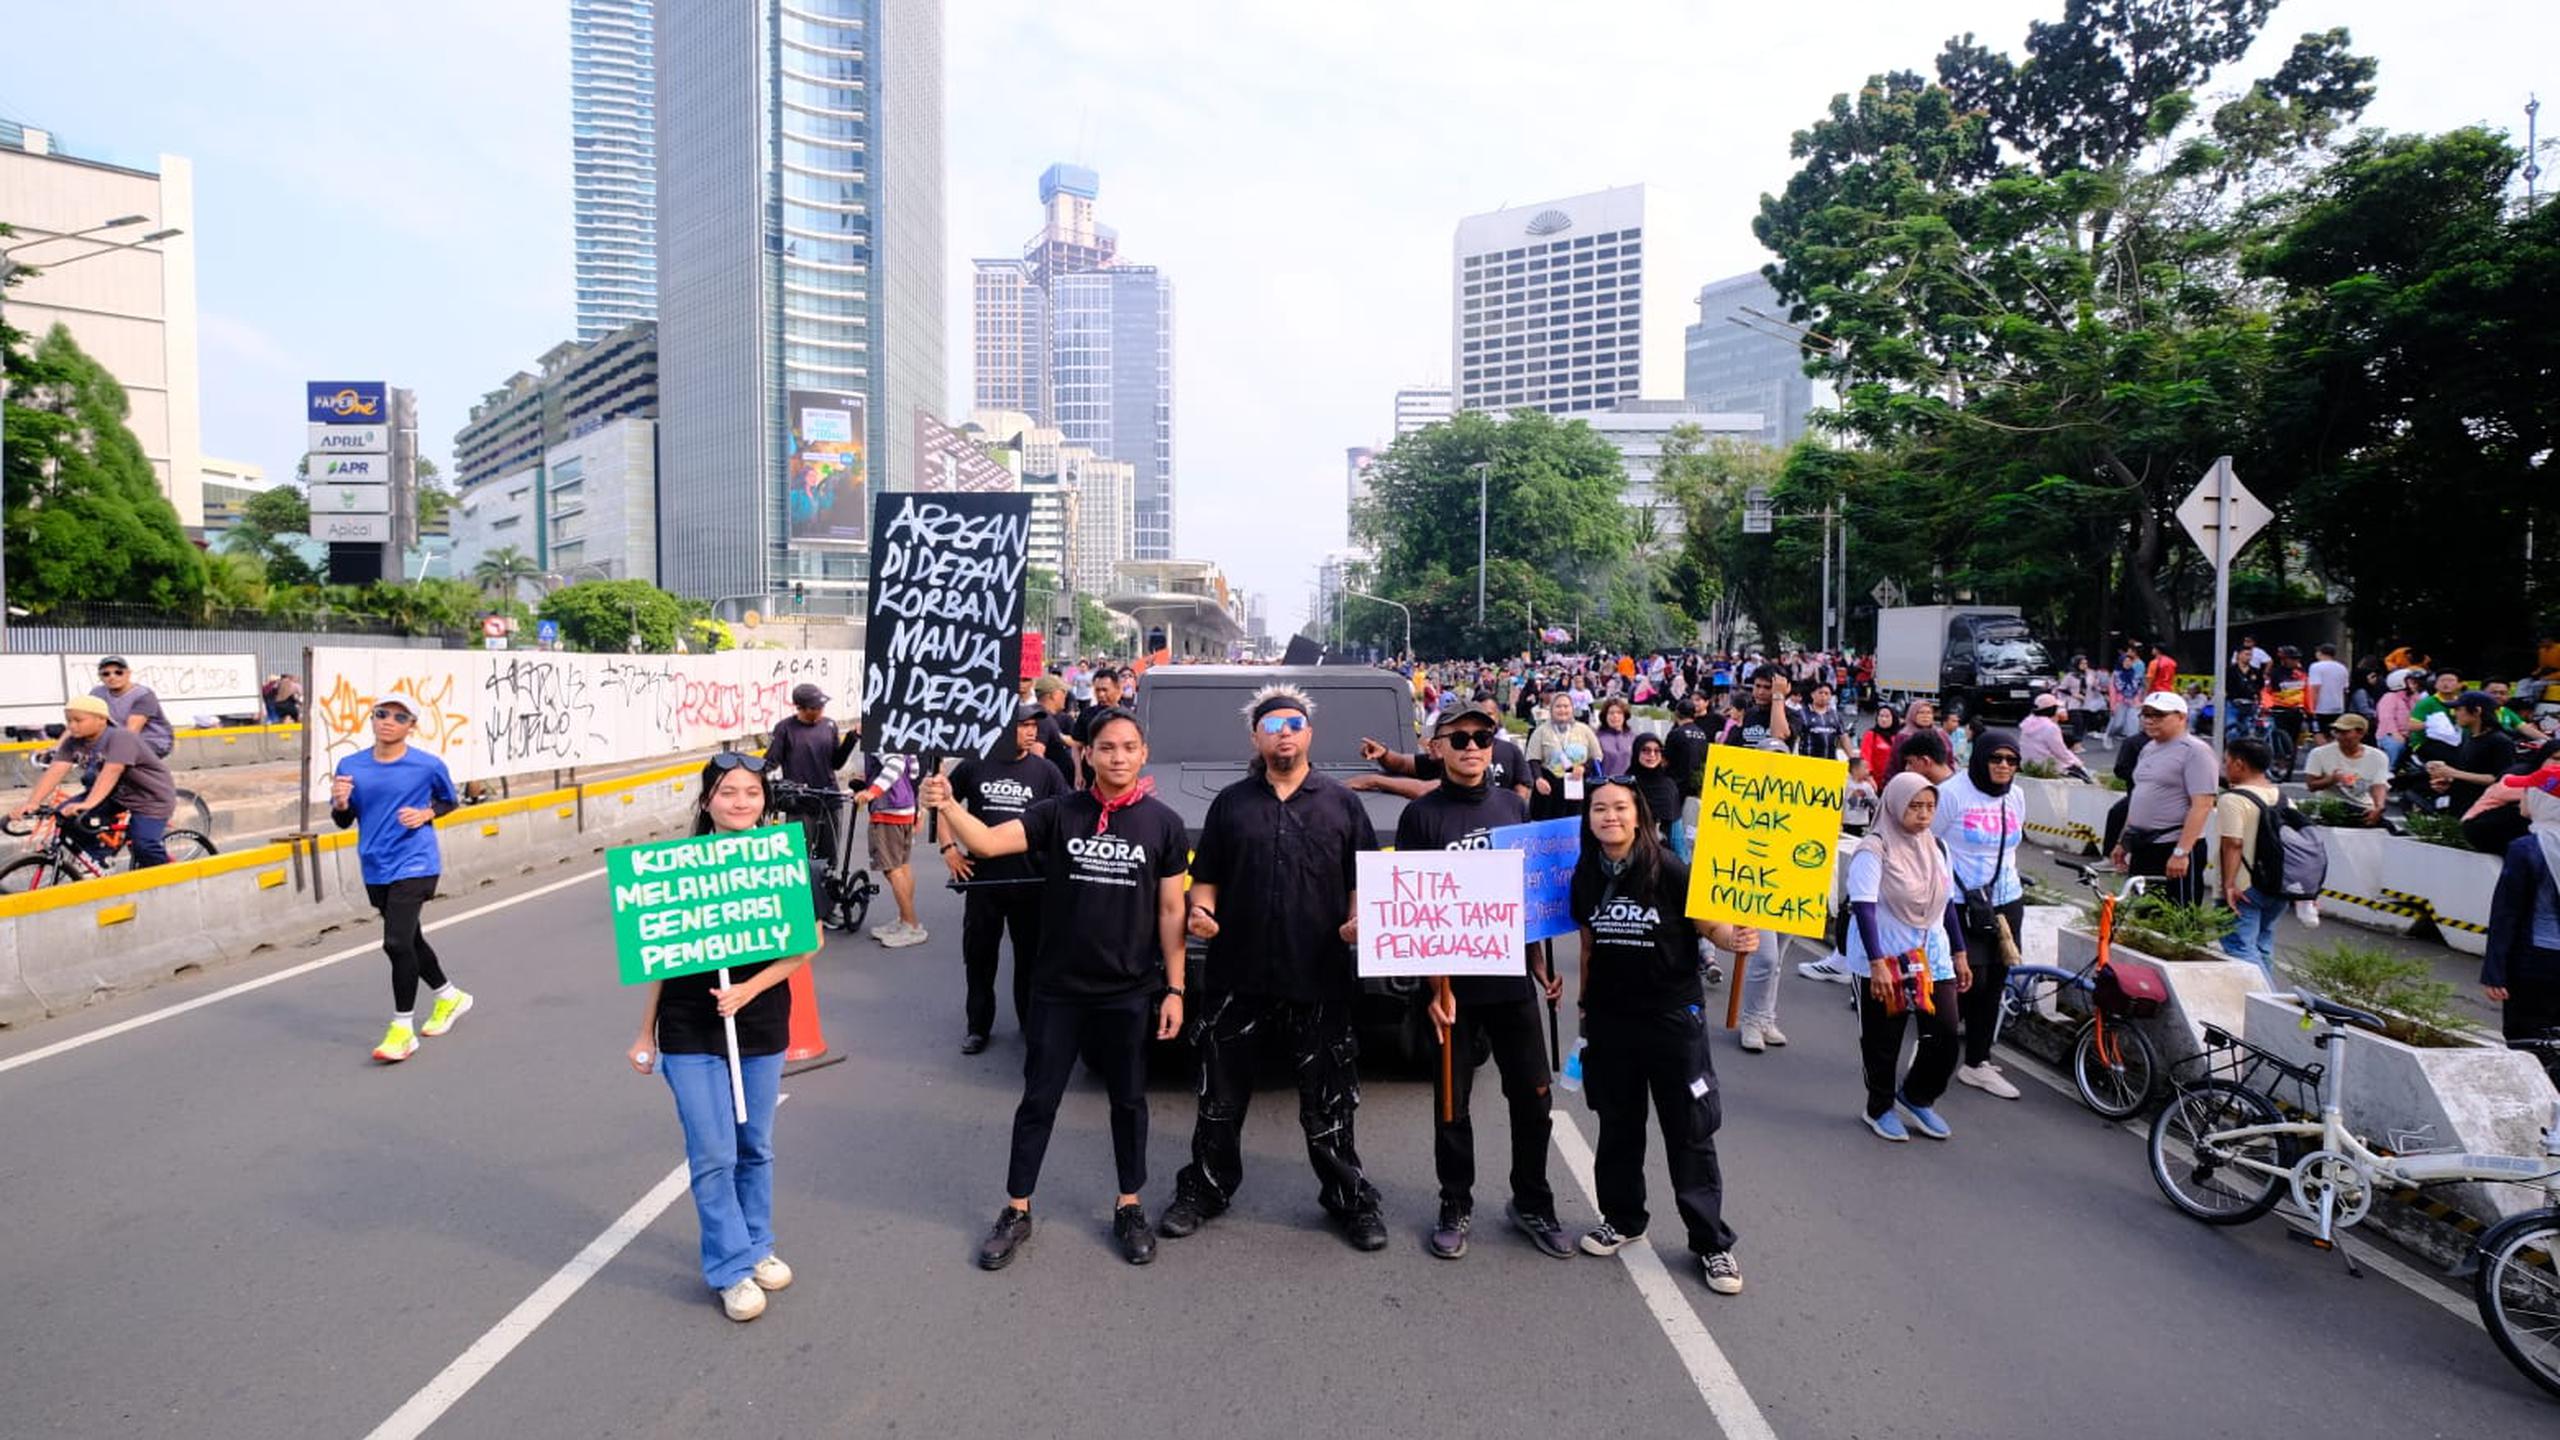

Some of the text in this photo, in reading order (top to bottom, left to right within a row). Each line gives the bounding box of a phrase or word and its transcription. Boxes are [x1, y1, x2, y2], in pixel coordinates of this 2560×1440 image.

[320, 435, 366, 447] APRIL
[338, 461, 369, 474] APR
[328, 523, 372, 539] Apical
[885, 496, 1030, 557] AROGAN
[911, 547, 1026, 592] DEPAN
[874, 580, 1018, 637] KORBAN,
[887, 619, 1002, 679] MANJA
[905, 666, 1019, 727] DEPAN
[878, 708, 1003, 760] HAKIM
[980, 782, 1033, 798] OZORA
[1713, 766, 1844, 811] KEAMANAN
[1712, 800, 1792, 833] ANAK
[631, 832, 794, 876] KORUPTOR
[1067, 837, 1147, 864] OZORA
[615, 859, 808, 912] MELAHIRKAN
[1392, 865, 1461, 902] KITA
[1712, 858, 1780, 889] HAK
[638, 894, 783, 941] GENERASI
[1371, 900, 1453, 932] TIDAK
[1454, 902, 1519, 929] TAKUT
[640, 923, 791, 975] PEMBULLY
[1375, 928, 1511, 960] PENGUASA!
